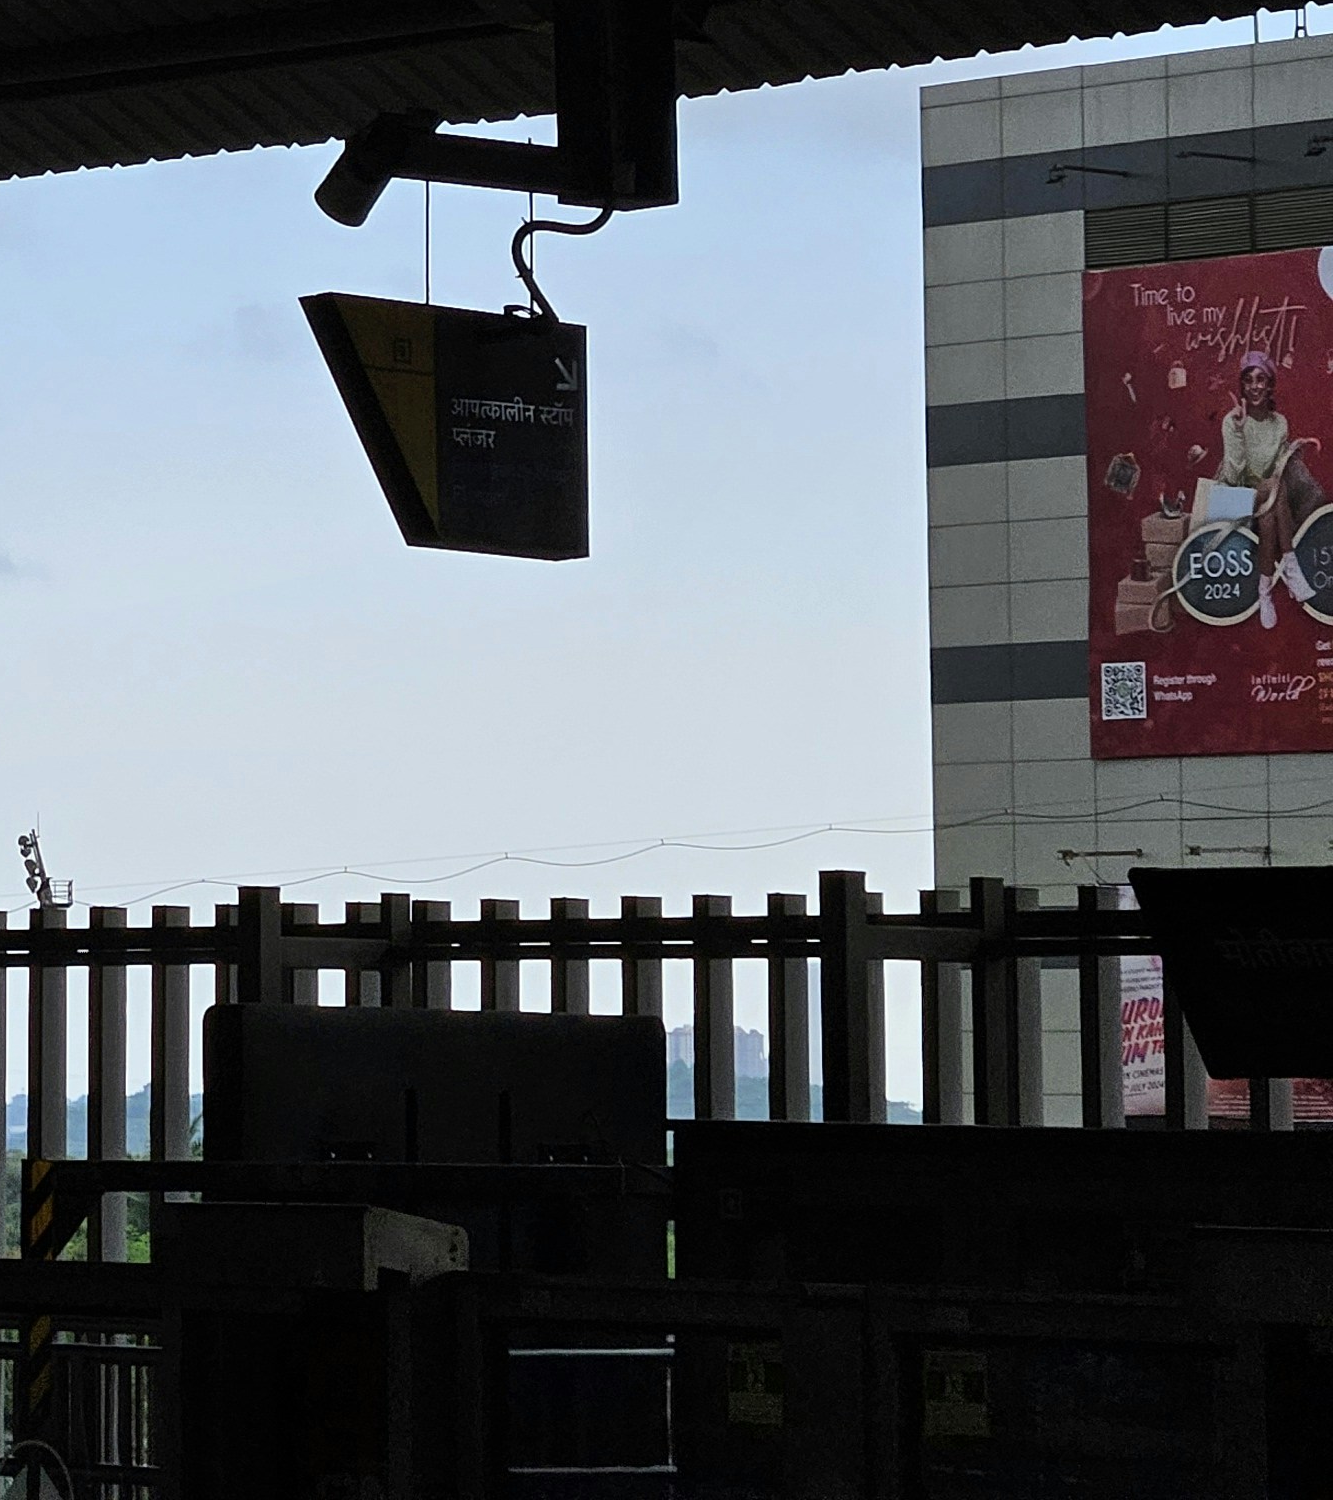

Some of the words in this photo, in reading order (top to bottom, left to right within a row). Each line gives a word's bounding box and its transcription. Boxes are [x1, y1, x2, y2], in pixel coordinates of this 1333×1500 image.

[1130, 283, 1169, 307] Time
[1176, 282, 1195, 303] to
[1167, 305, 1196, 326] live
[1203, 305, 1227, 327] my
[451, 396, 536, 423] आपत्कालीन
[539, 402, 574, 427] स्टॉप
[1189, 549, 1254, 579] EOSS
[1204, 583, 1241, 600] 2024
